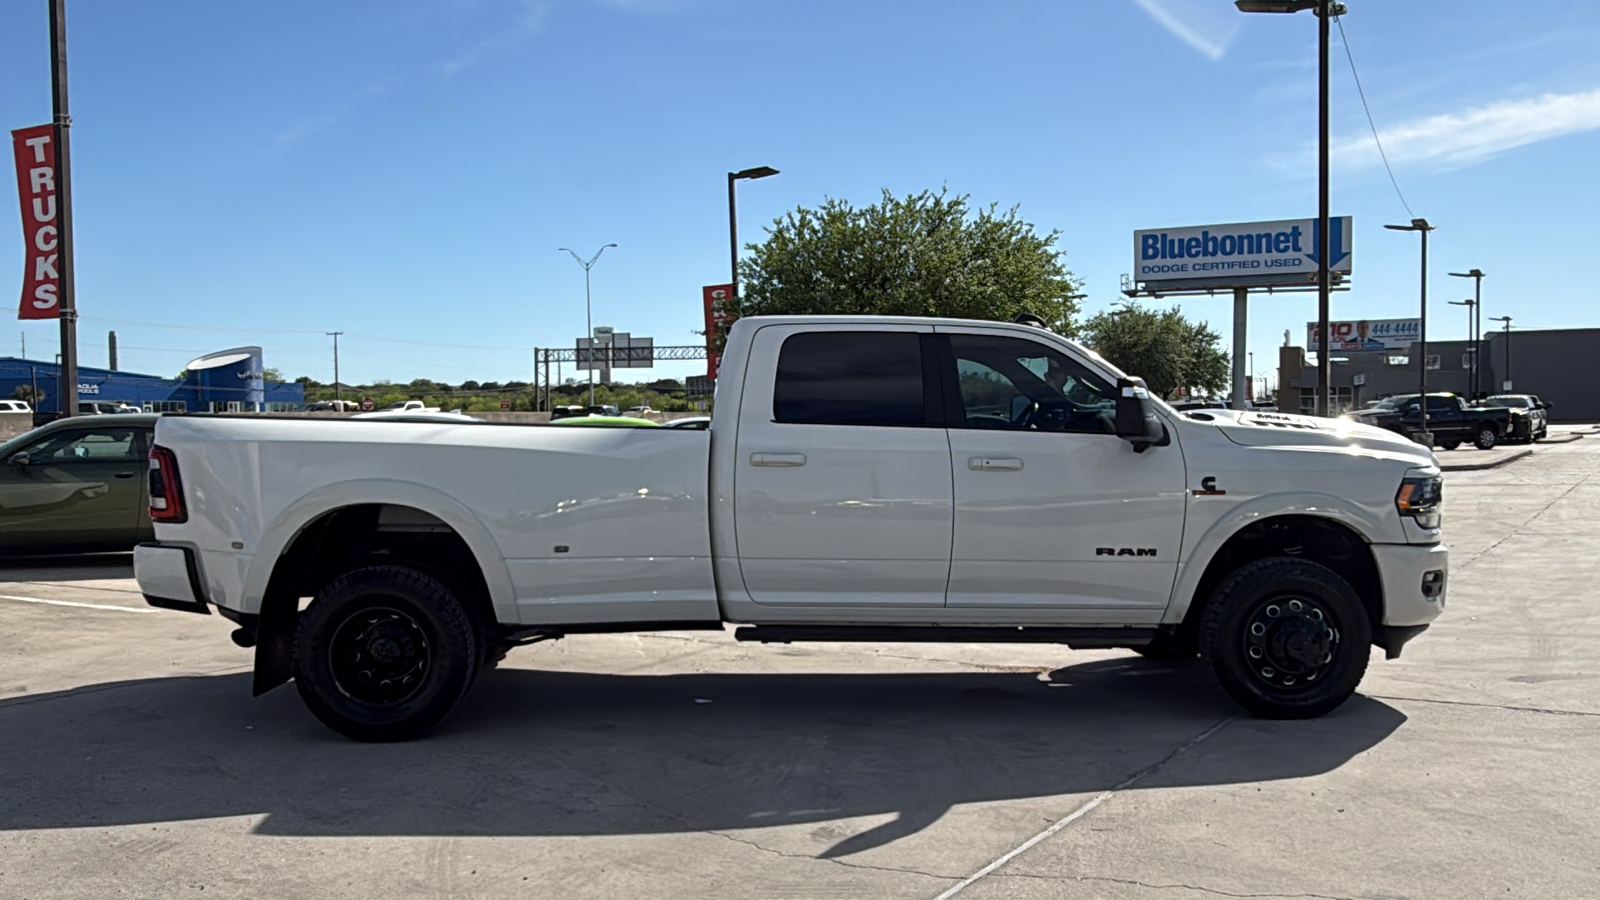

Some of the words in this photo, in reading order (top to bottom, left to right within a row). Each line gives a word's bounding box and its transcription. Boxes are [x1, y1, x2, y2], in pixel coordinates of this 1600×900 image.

[26, 135, 59, 309] TRUCKS
[1141, 226, 1302, 260] Bluebonnet
[1142, 264, 1189, 274] DODGE
[1192, 260, 1260, 272] CERTIFIED
[1265, 257, 1302, 267] USED
[1372, 323, 1418, 334] 444-4444
[1096, 548, 1157, 556] RAM
